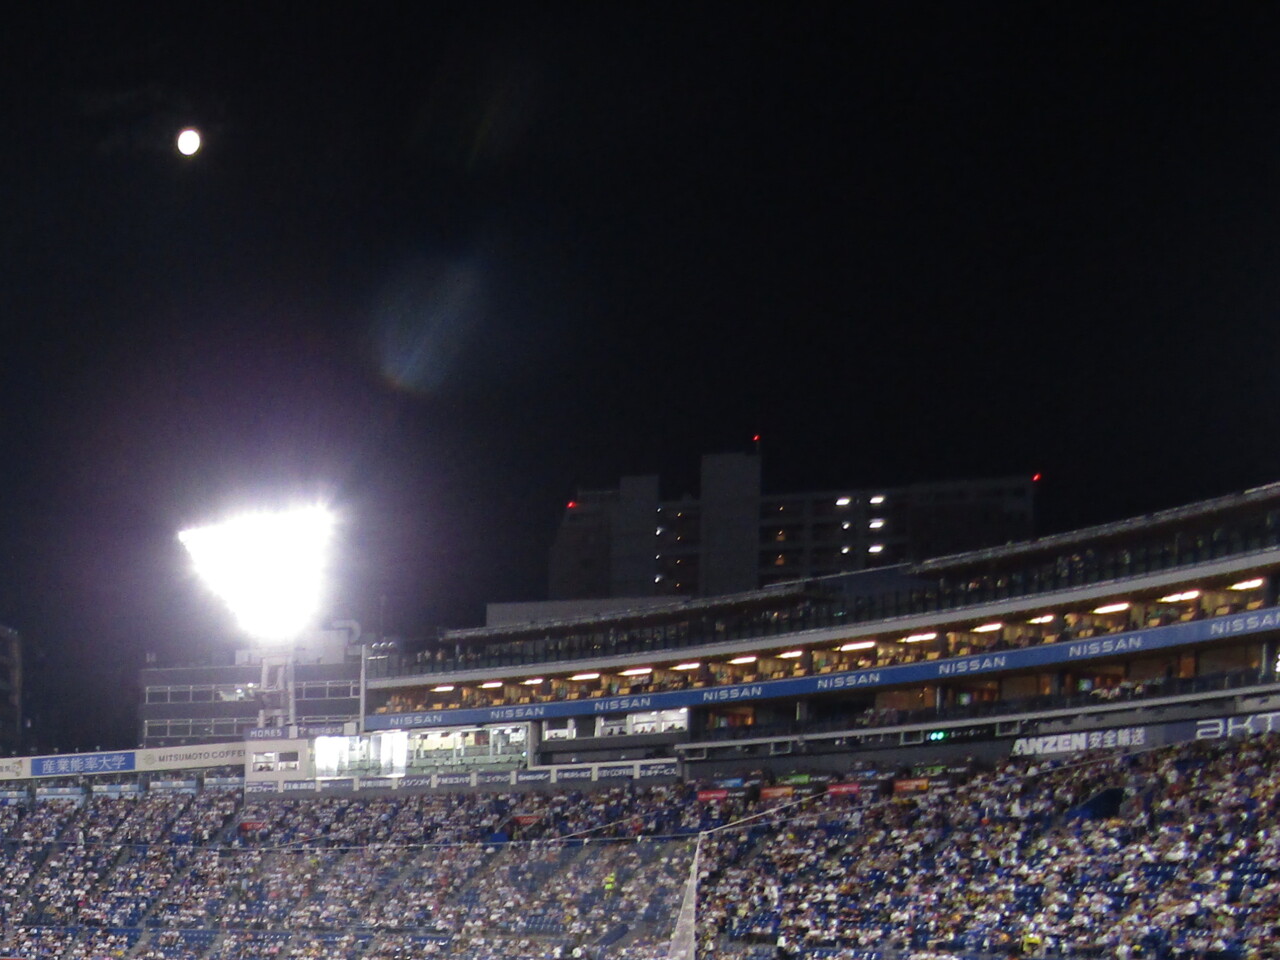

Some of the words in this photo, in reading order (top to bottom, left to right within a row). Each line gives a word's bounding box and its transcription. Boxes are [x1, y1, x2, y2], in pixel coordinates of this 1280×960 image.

[1069, 636, 1143, 658] NISSAN
[938, 656, 1006, 675] NISSAN
[816, 673, 881, 690] NISSAN
[703, 686, 763, 702] NISSAN
[594, 697, 651, 712] NISSAN
[389, 715, 443, 726] NISSAN
[490, 707, 545, 719] NISSAN
[1012, 732, 1088, 757] ANZEN
[1089, 727, 1146, 749] 安全輸送
[41, 753, 126, 774] 産業能率大学
[158, 752, 211, 763] MITSUMOTO
